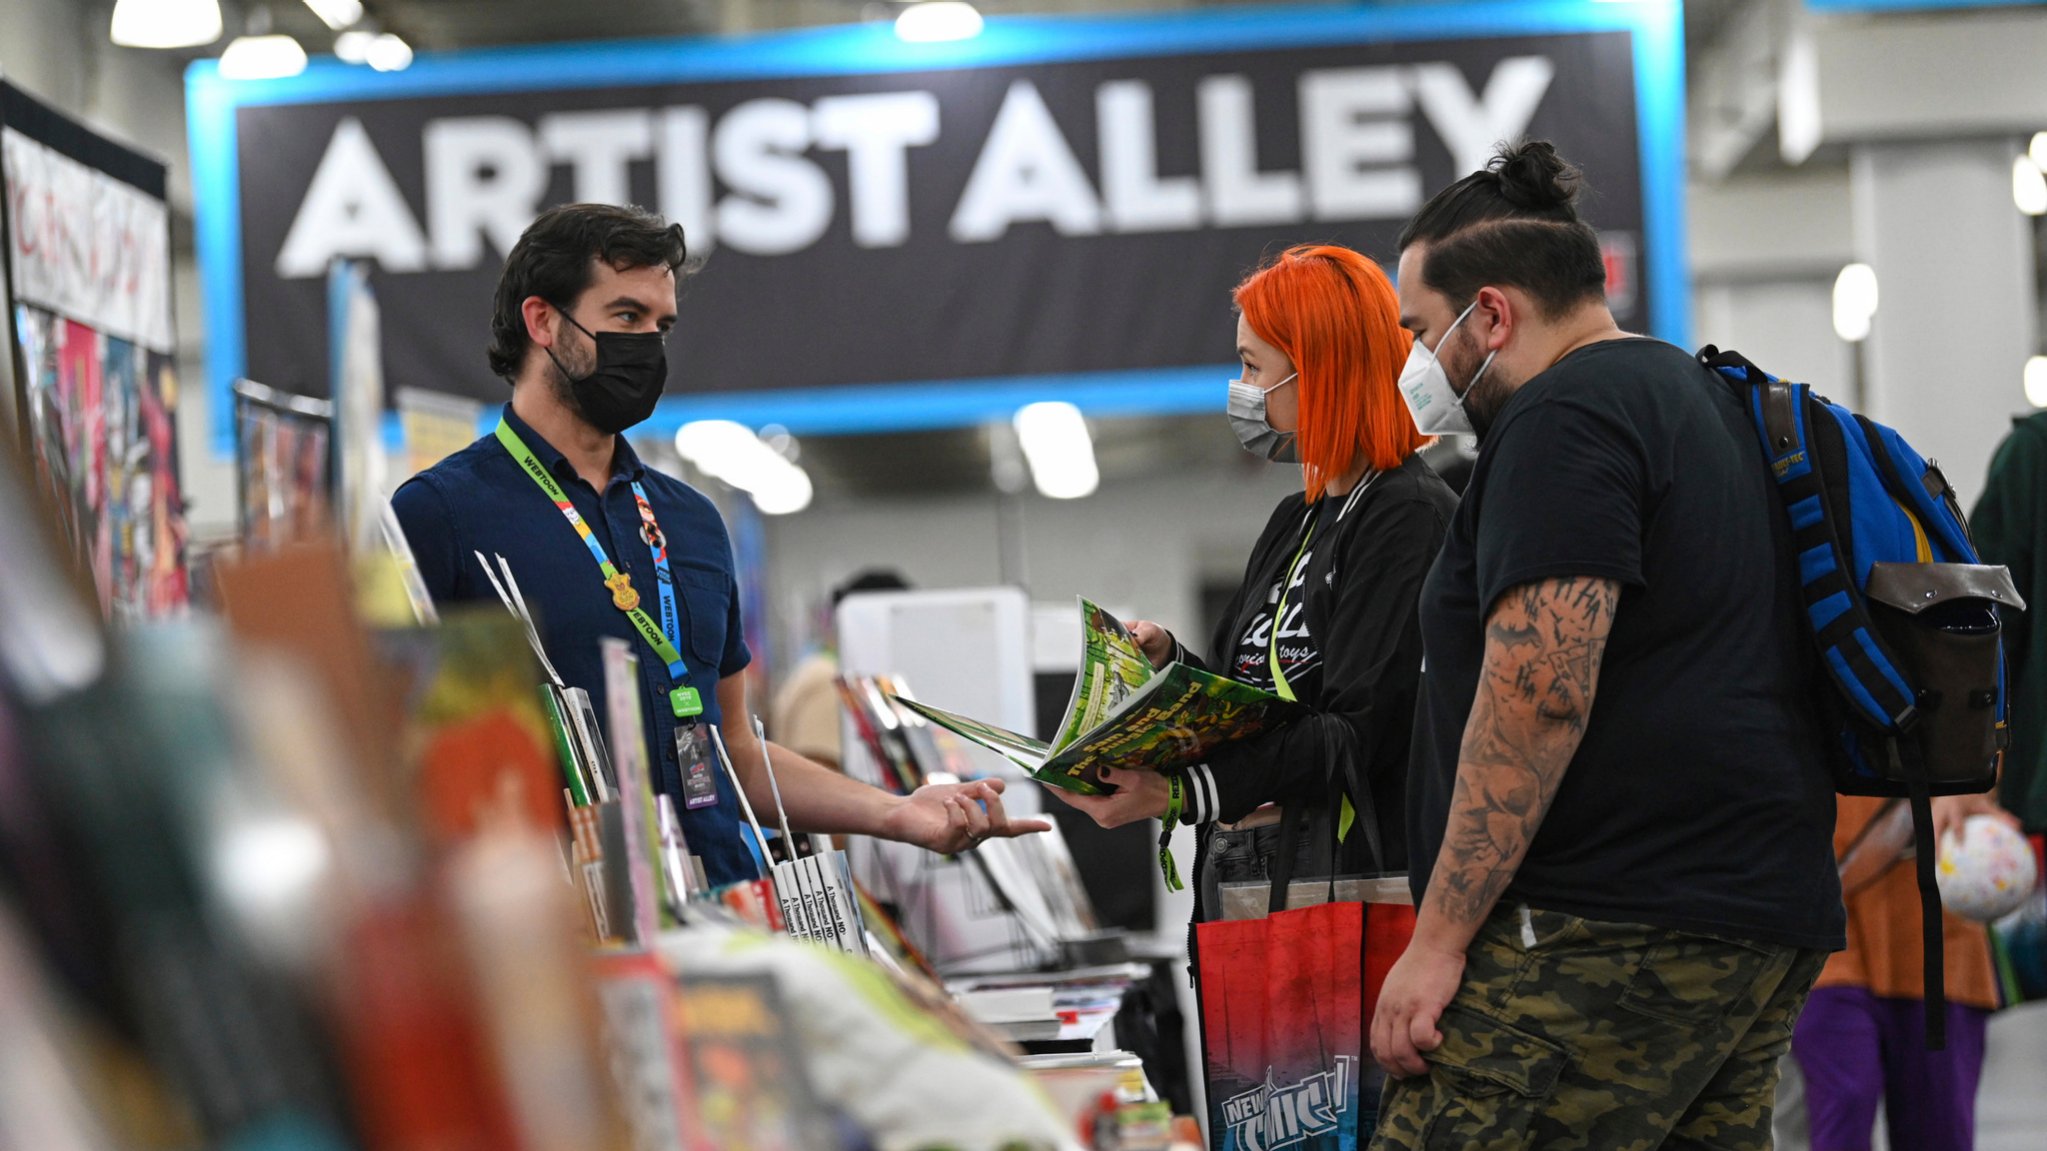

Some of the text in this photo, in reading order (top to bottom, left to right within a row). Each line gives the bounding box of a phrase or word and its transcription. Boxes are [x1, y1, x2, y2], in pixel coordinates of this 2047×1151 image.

[275, 91, 941, 279] ARTIST
[947, 54, 1555, 243] ALLEY
[524, 456, 559, 496] WEBTOON
[632, 609, 663, 646] EBTOON
[663, 595, 675, 642] WEBTOON
[1279, 645, 1309, 662] toys
[1067, 755, 1099, 777] The
[1156, 681, 1203, 722] Band
[1083, 731, 1123, 753] Sam
[1126, 707, 1161, 735] and
[784, 905, 797, 934] Thousand
[793, 903, 806, 932] Thousand
[806, 900, 819, 929] Thousand
[818, 896, 830, 926] Thousand
[828, 892, 842, 922] Thousand
[1226, 1089, 1265, 1123] NEW
